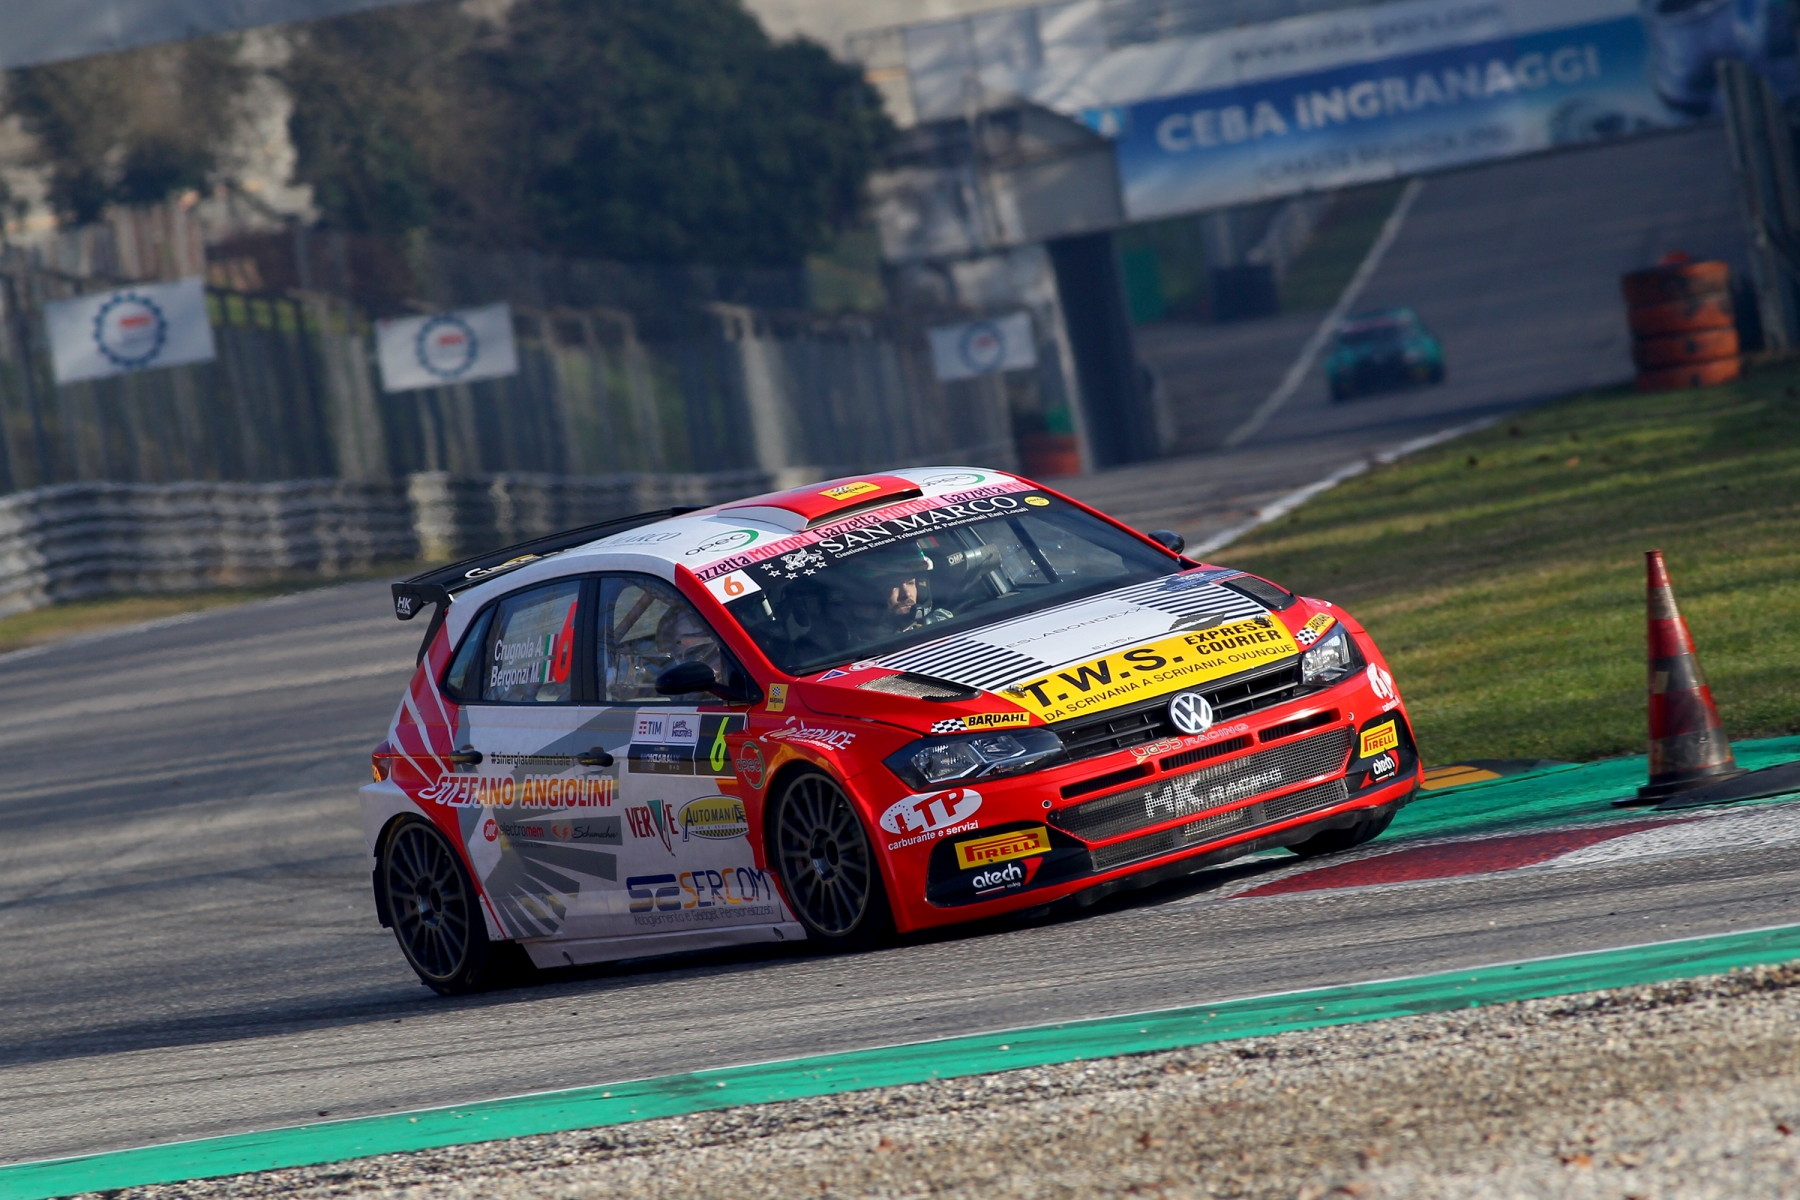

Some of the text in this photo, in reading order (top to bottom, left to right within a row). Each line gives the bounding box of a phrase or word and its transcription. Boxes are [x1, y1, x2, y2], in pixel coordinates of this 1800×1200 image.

[1155, 44, 1599, 153] CEBA INGRANAGGI
[750, 534, 811, 561] MOTORI
[814, 514, 881, 540] Gazzetta
[876, 498, 940, 521] MOTORI
[940, 486, 1007, 504] Gazzetta
[819, 496, 1018, 554] SAN MARCO
[834, 545, 869, 559] Gestione
[868, 537, 896, 549] Entrate
[895, 527, 934, 541] Tributarie
[941, 514, 988, 528] Patrimoniali
[1003, 506, 1029, 515] Locali
[685, 533, 746, 556] opec
[948, 552, 965, 565] OMP
[723, 575, 746, 597] 6
[397, 596, 412, 610] HK
[553, 601, 578, 684] 6
[1184, 618, 1271, 646] EXPRESS
[1196, 630, 1282, 655] COURIER
[494, 635, 544, 666] Crugnola A.
[490, 662, 540, 691] Bergonzi M.
[1023, 648, 1185, 708] T.W.S.
[1043, 643, 1296, 722] DA SCRIVANIA A SCRIVANIA OVUNQUE
[648, 721, 663, 735] TIM
[968, 713, 1028, 727] BARDAHL
[1184, 723, 1250, 746] RACING
[709, 716, 730, 772] 6
[1363, 726, 1395, 753] PIRELLI
[1372, 753, 1396, 775] atech
[419, 774, 614, 809] STEFANO ANGIOLINI
[1144, 767, 1283, 818] HK RACING
[894, 788, 965, 837] LTP
[888, 832, 937, 851] carburante
[945, 819, 979, 836] servizi
[963, 833, 1041, 863] PIRELLI
[679, 866, 771, 909] SERCOM
[972, 863, 1023, 890] atech
[690, 908, 719, 923] Gadget
